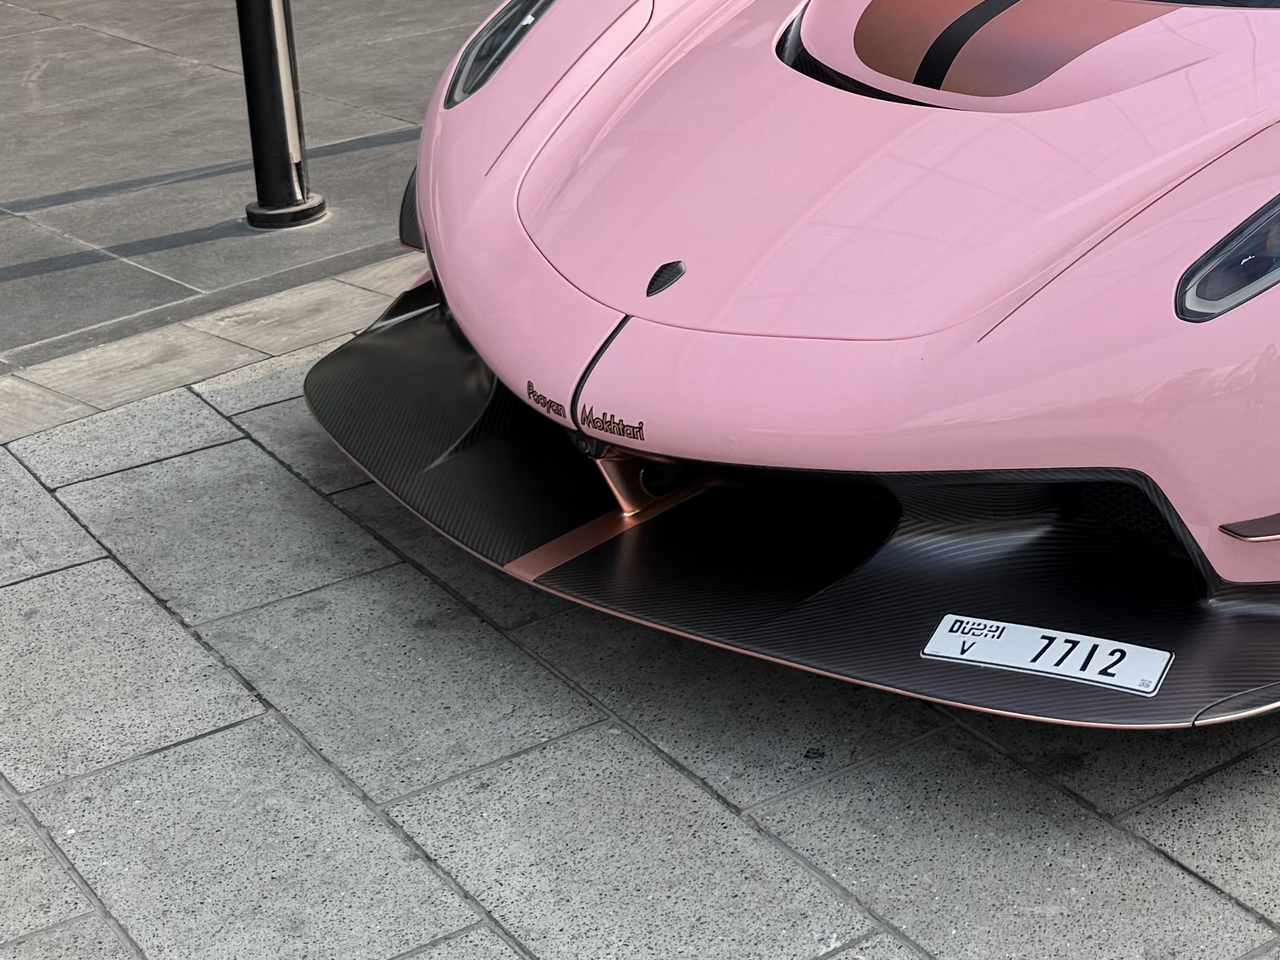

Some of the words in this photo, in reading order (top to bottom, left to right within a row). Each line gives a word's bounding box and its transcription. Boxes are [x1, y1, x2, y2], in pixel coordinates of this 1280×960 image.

[526, 380, 567, 419] Pooyan
[580, 403, 646, 441] Mokhtari
[959, 640, 977, 656] V
[1029, 634, 1128, 678] 7712
